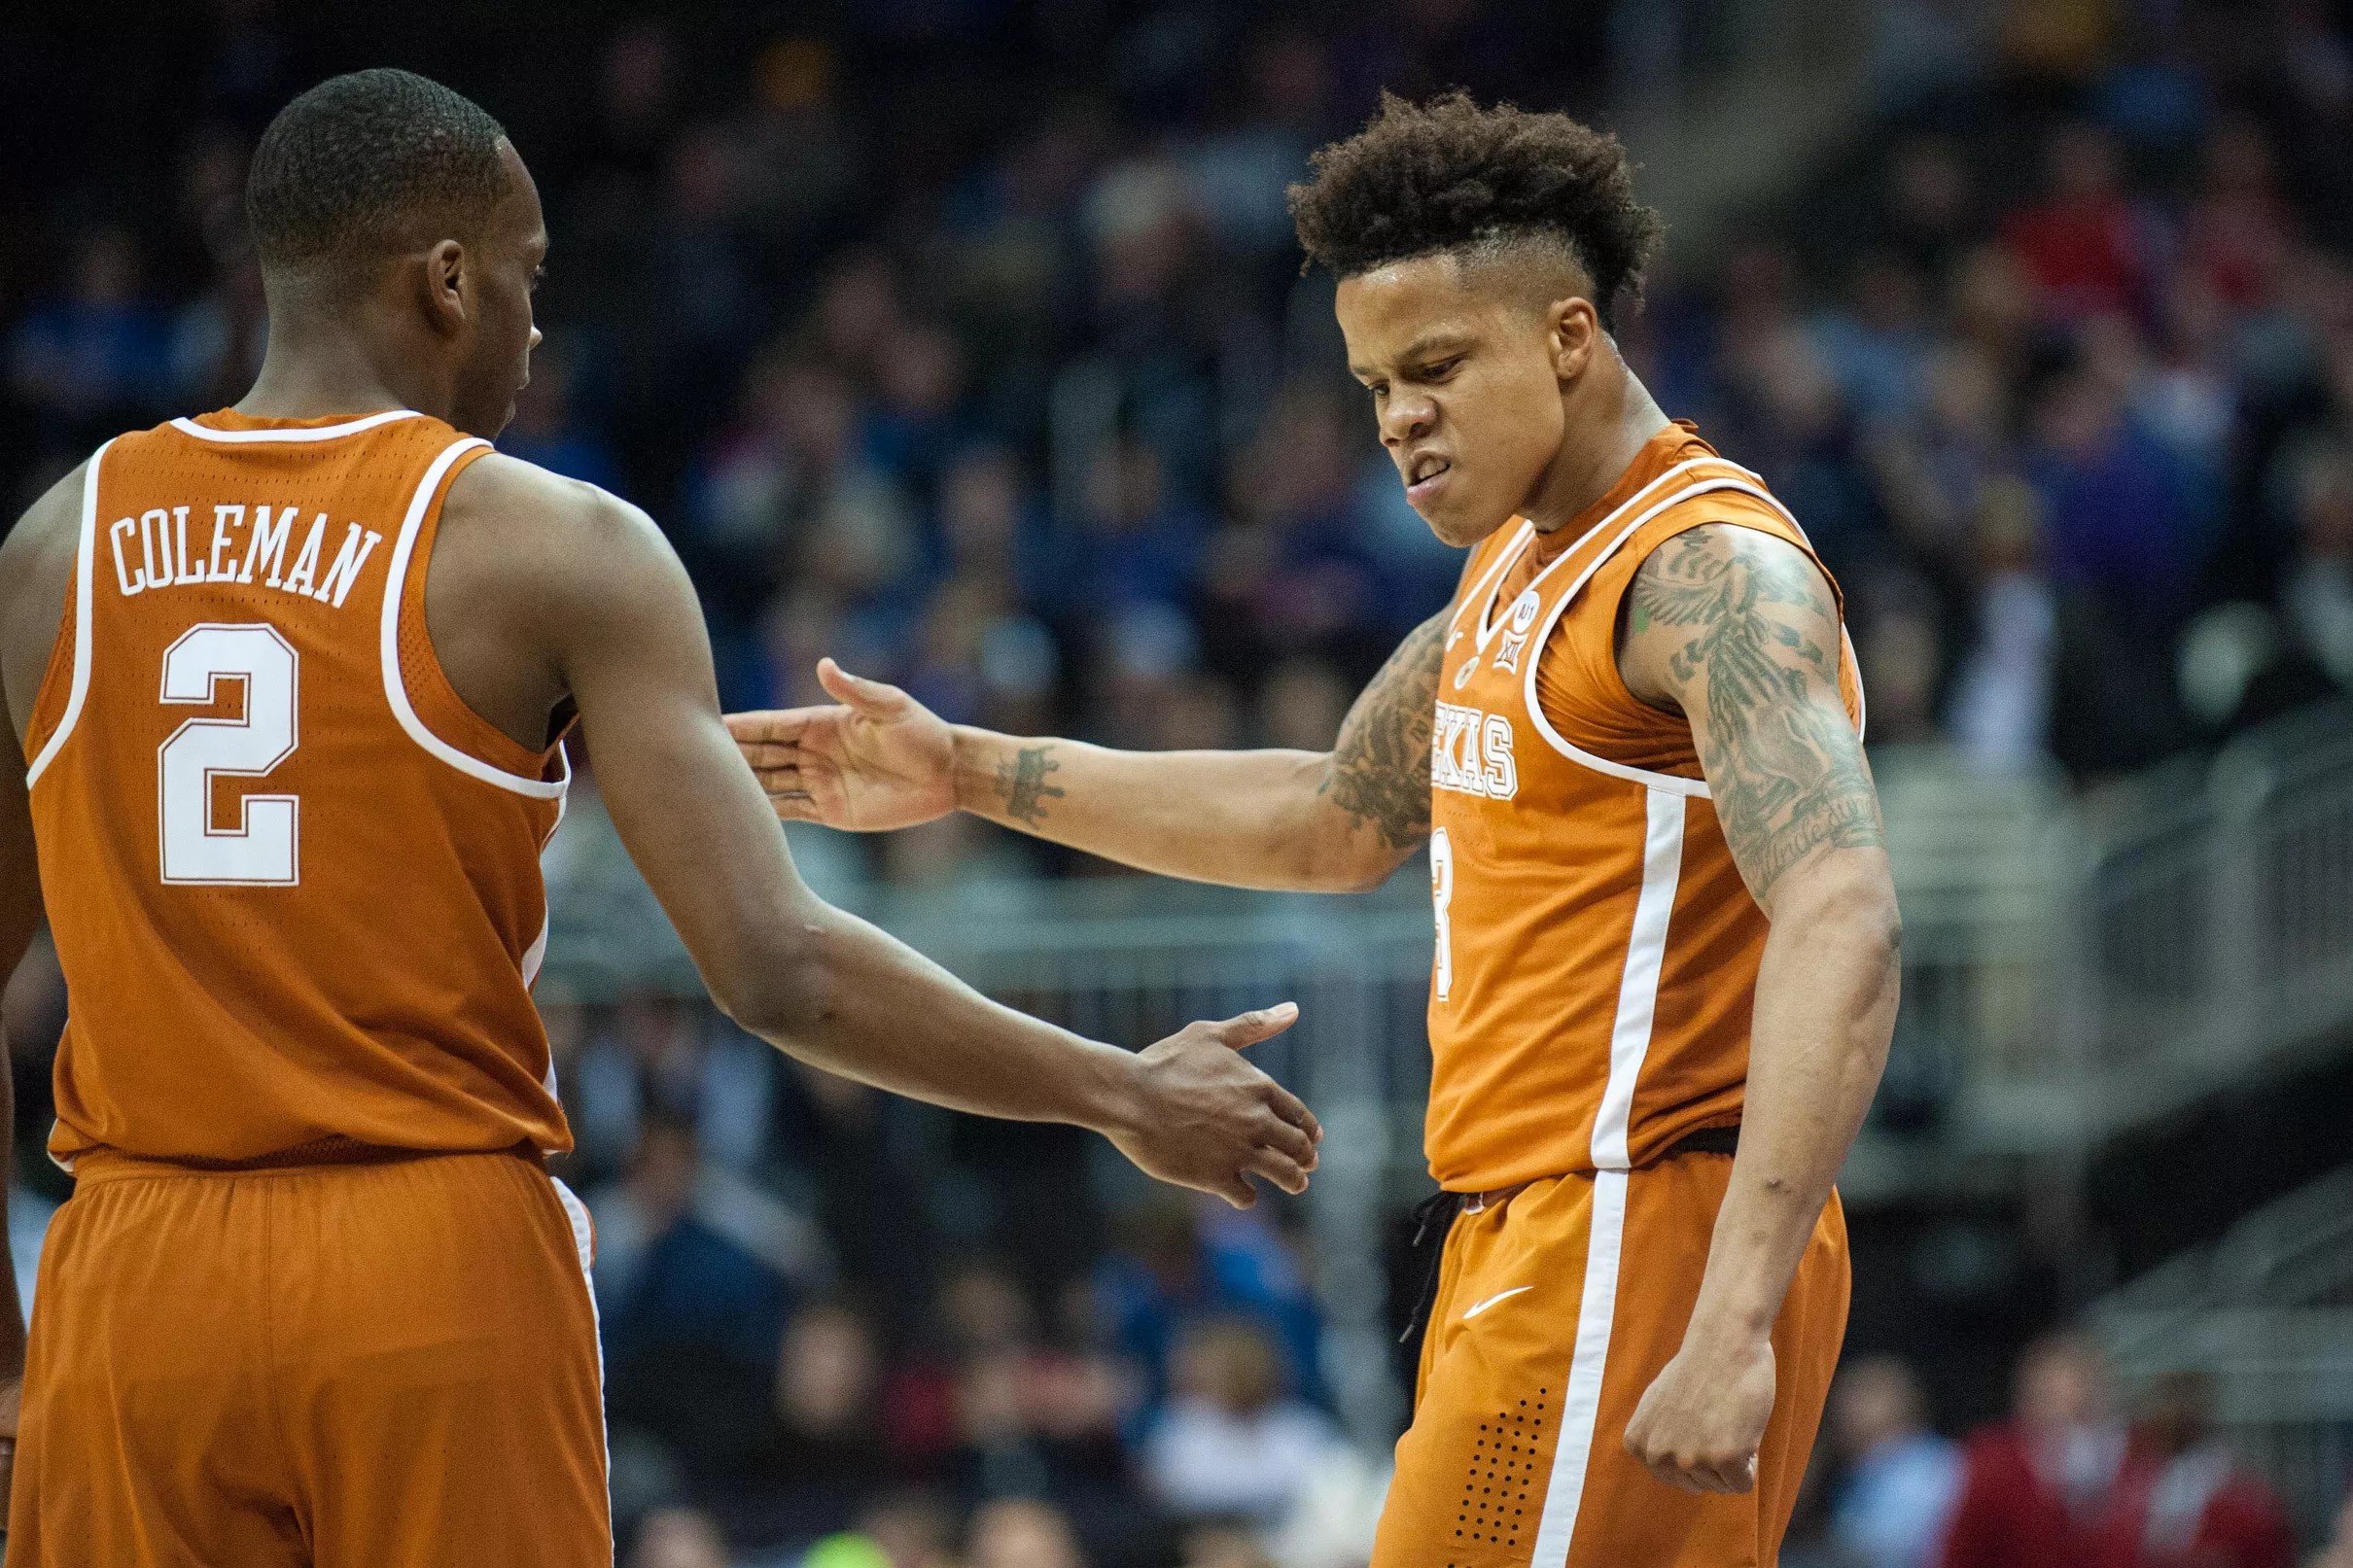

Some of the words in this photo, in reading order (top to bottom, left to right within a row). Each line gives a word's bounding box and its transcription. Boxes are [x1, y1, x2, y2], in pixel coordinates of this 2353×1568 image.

[110, 505, 382, 609] COLEMAN
[158, 622, 299, 887] 2
[1430, 700, 1518, 801] EXAS
